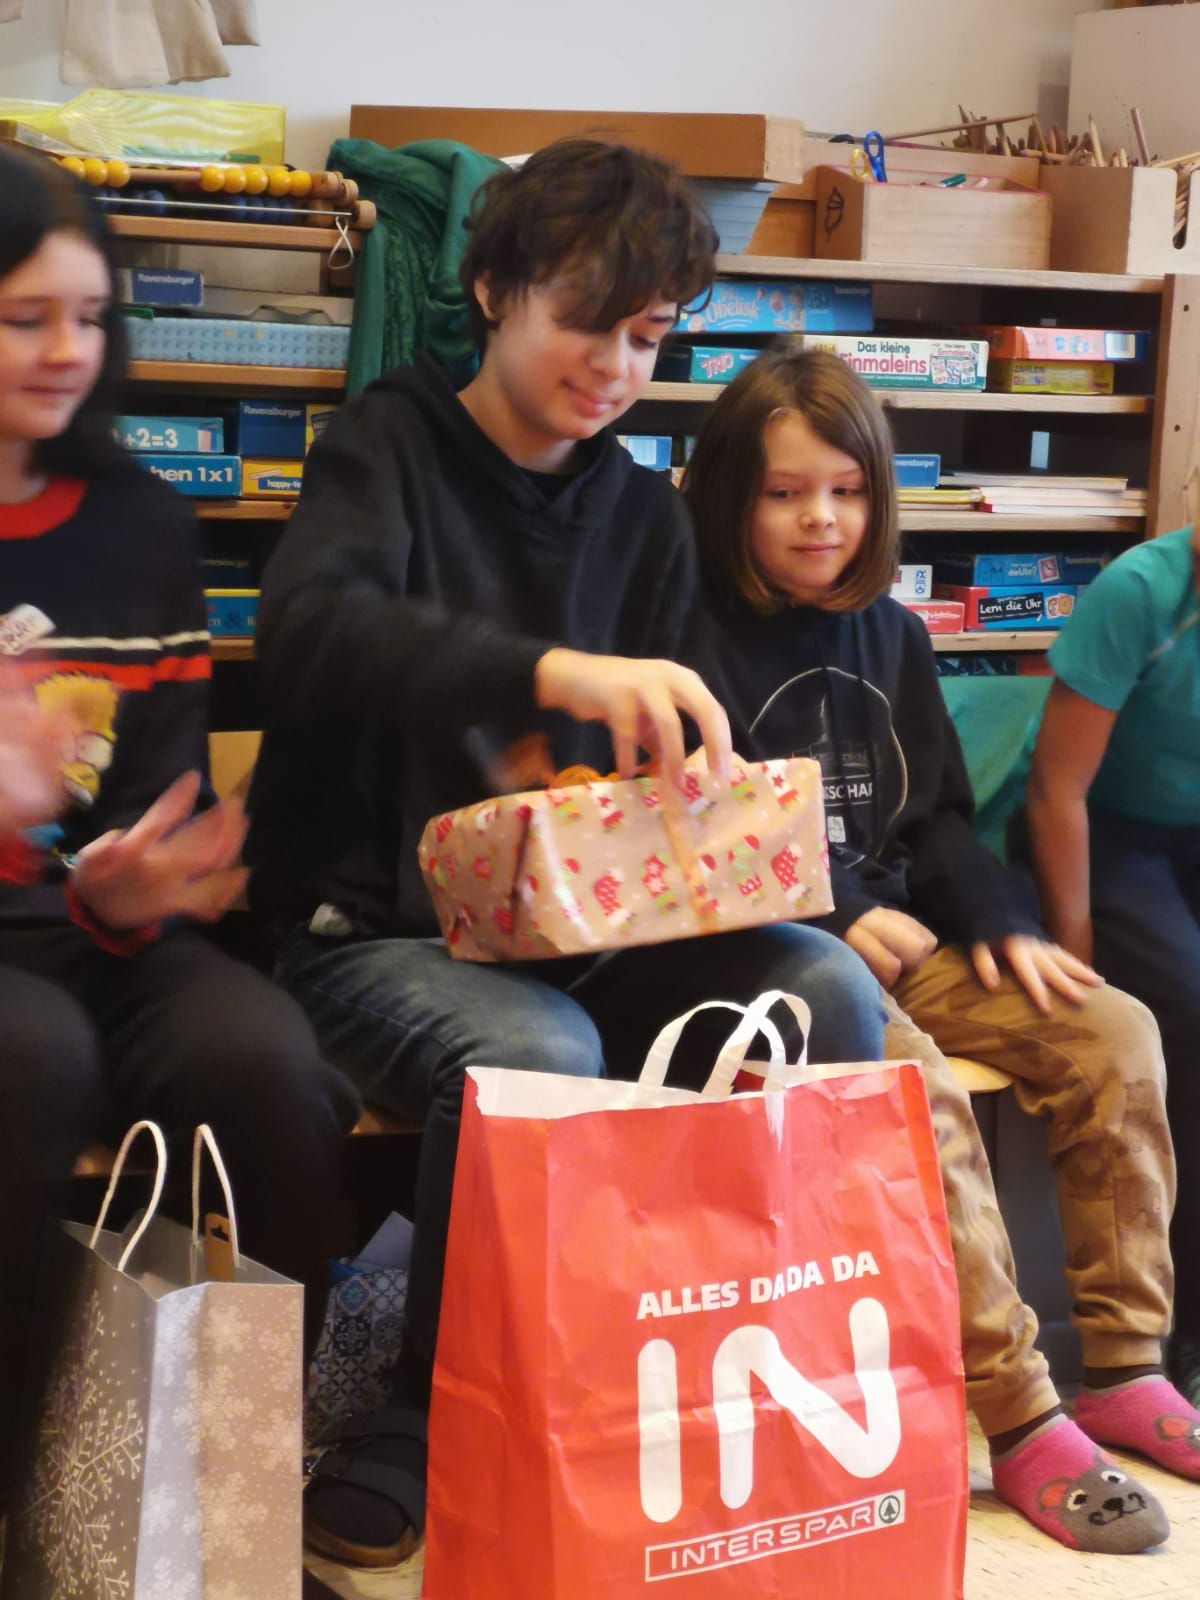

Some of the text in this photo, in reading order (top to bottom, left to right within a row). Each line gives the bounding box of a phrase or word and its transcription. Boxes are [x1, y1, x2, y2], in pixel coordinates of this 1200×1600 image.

[137, 273, 196, 286] Ravensburger
[857, 341, 911, 354] Das kleine
[839, 352, 927, 374] Einmaleins
[243, 405, 302, 418] Ravensburger
[197, 467, 233, 482] 1x1
[979, 603, 1003, 614] Lern
[1005, 600, 1023, 611] die
[1025, 599, 1043, 609] Uhr
[636, 1280, 741, 1320] ALLES
[831, 1250, 881, 1283] DA
[637, 1296, 902, 1524] IN
[670, 1504, 872, 1571] INTERSPAR
